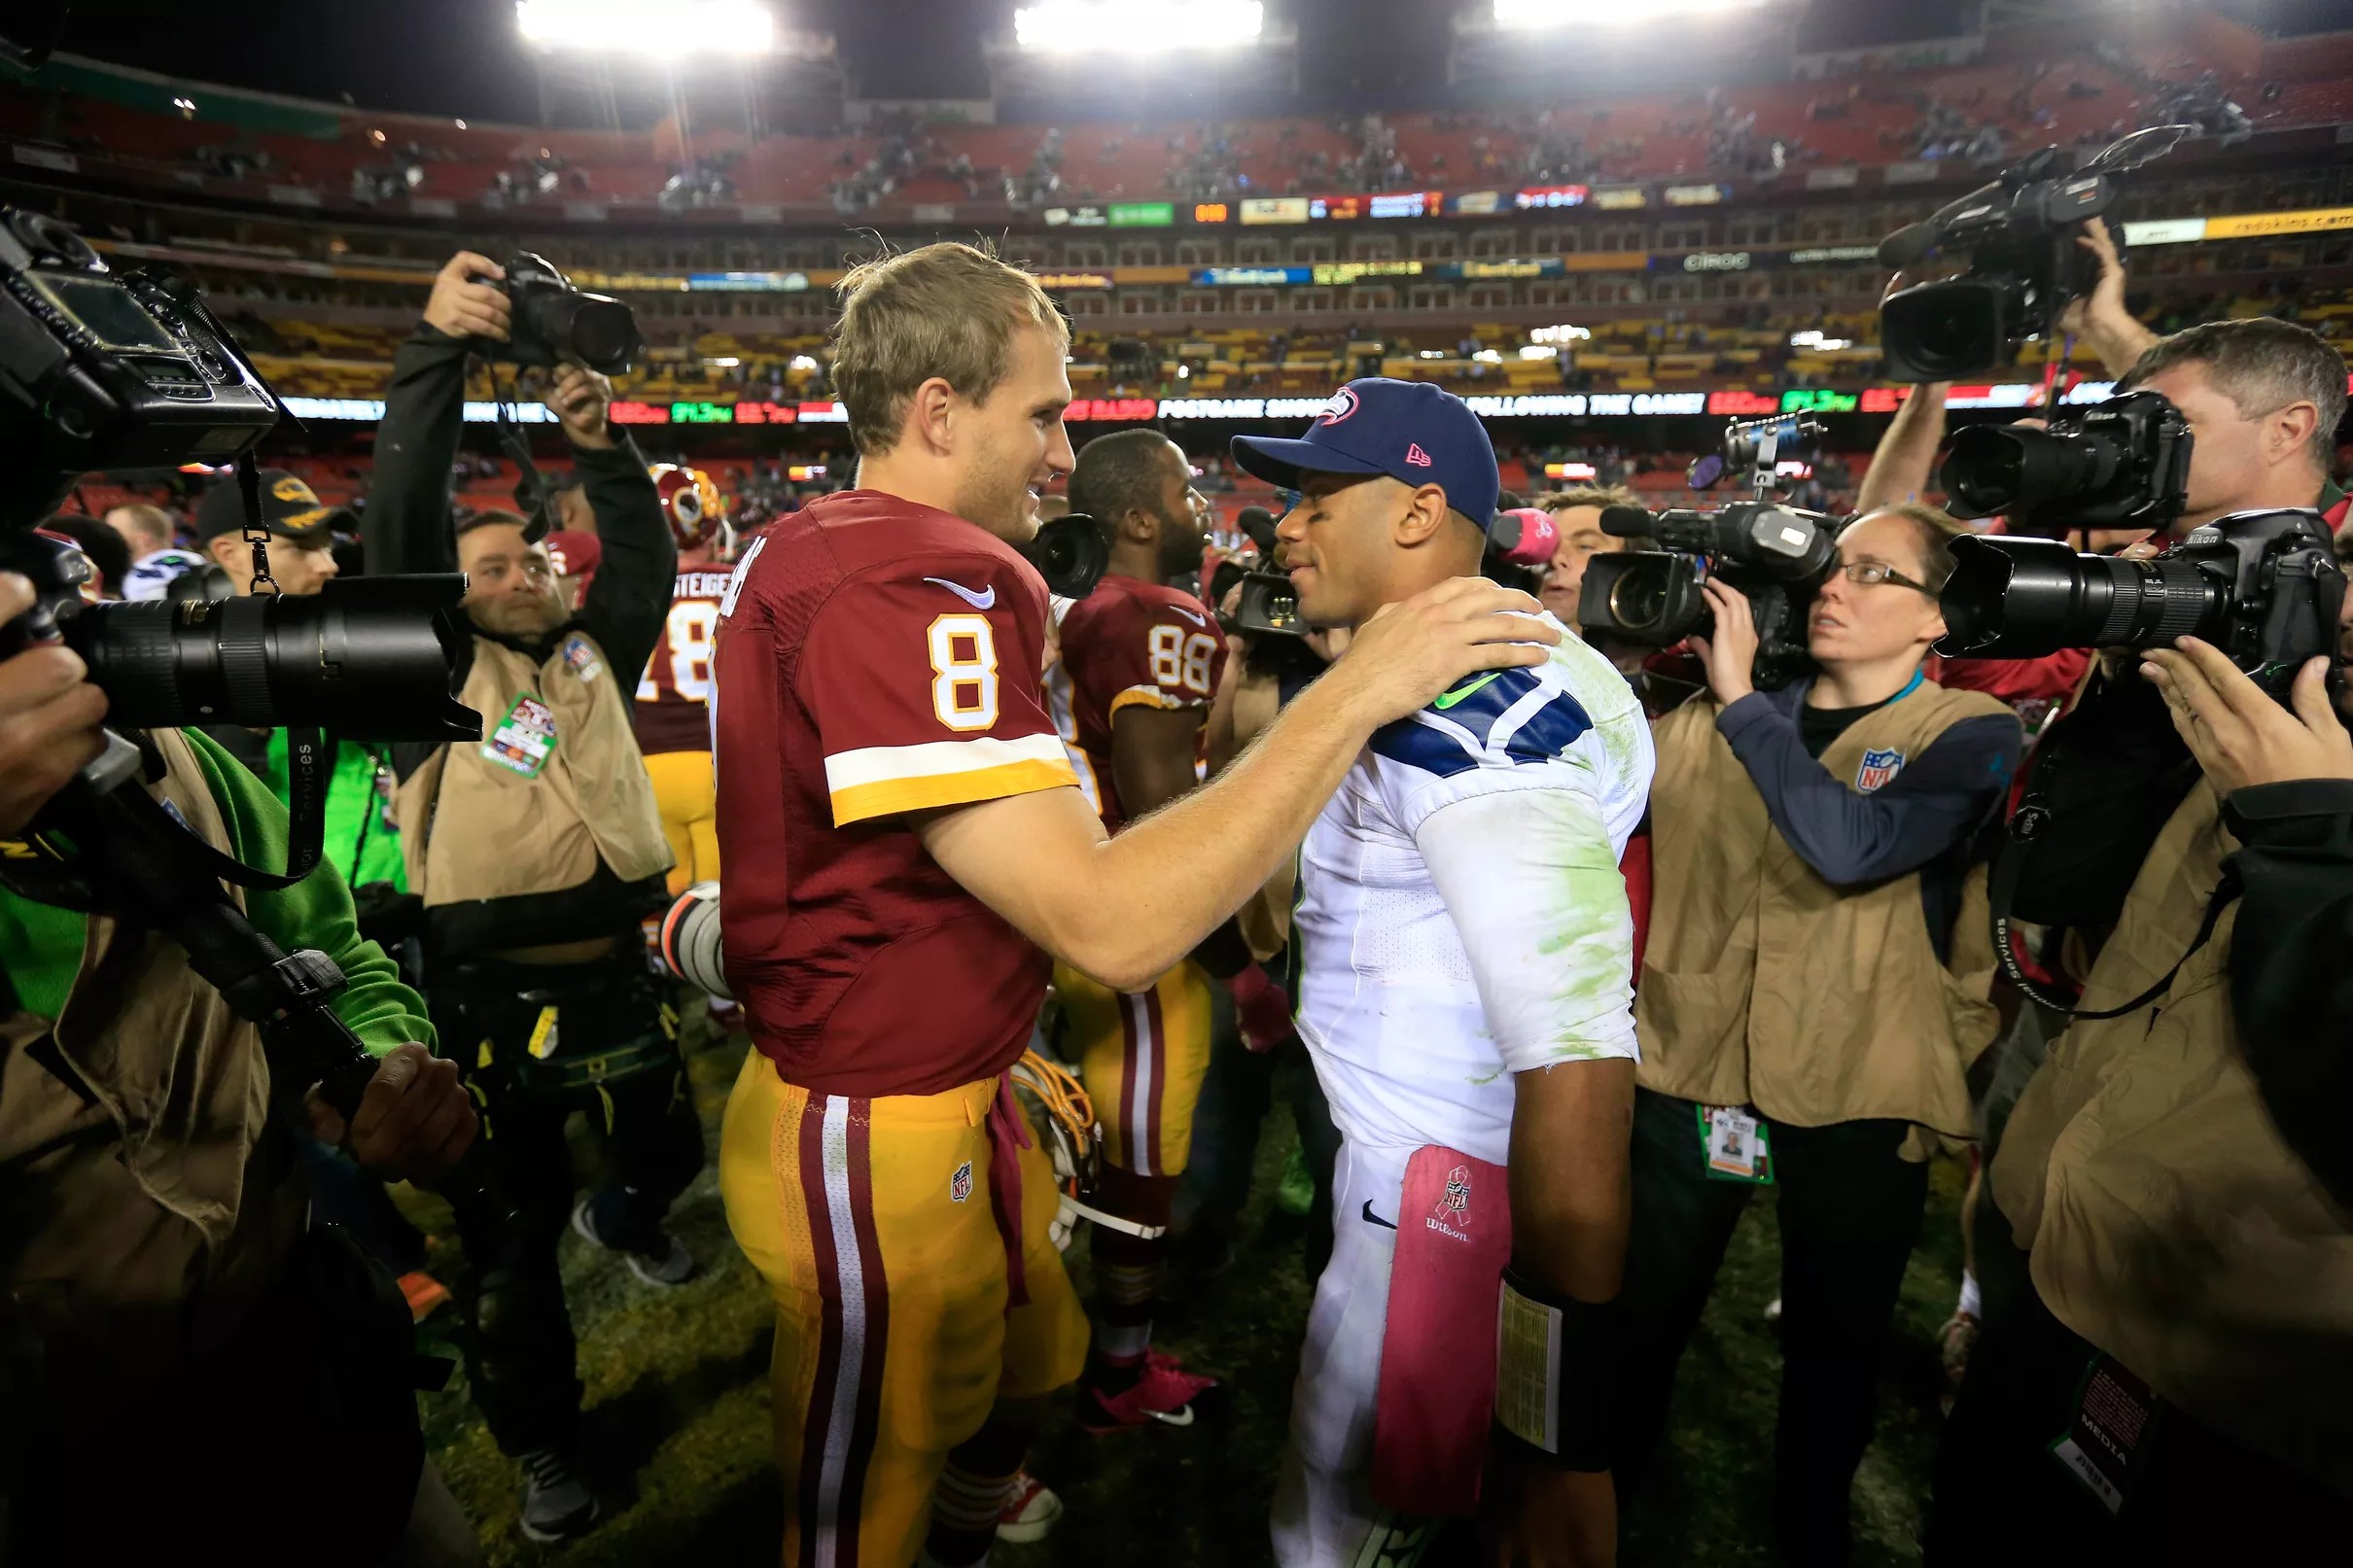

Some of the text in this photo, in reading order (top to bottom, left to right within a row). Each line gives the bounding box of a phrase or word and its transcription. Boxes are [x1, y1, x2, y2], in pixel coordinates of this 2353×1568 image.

[1157, 399, 1264, 419] POSTGAME
[1265, 398, 1328, 418] SHOW
[1466, 393, 1705, 417] FOLLOWING THE GAME!
[2186, 534, 2219, 545] Nikon
[1148, 624, 1217, 695] 88
[926, 612, 1001, 733] 8
[1997, 918, 2021, 980] Services
[954, 1175, 969, 1197] NFL
[1445, 1191, 1465, 1208] NFL
[1425, 1216, 1468, 1242] Wilson
[2081, 1412, 2127, 1467] MEDIA
